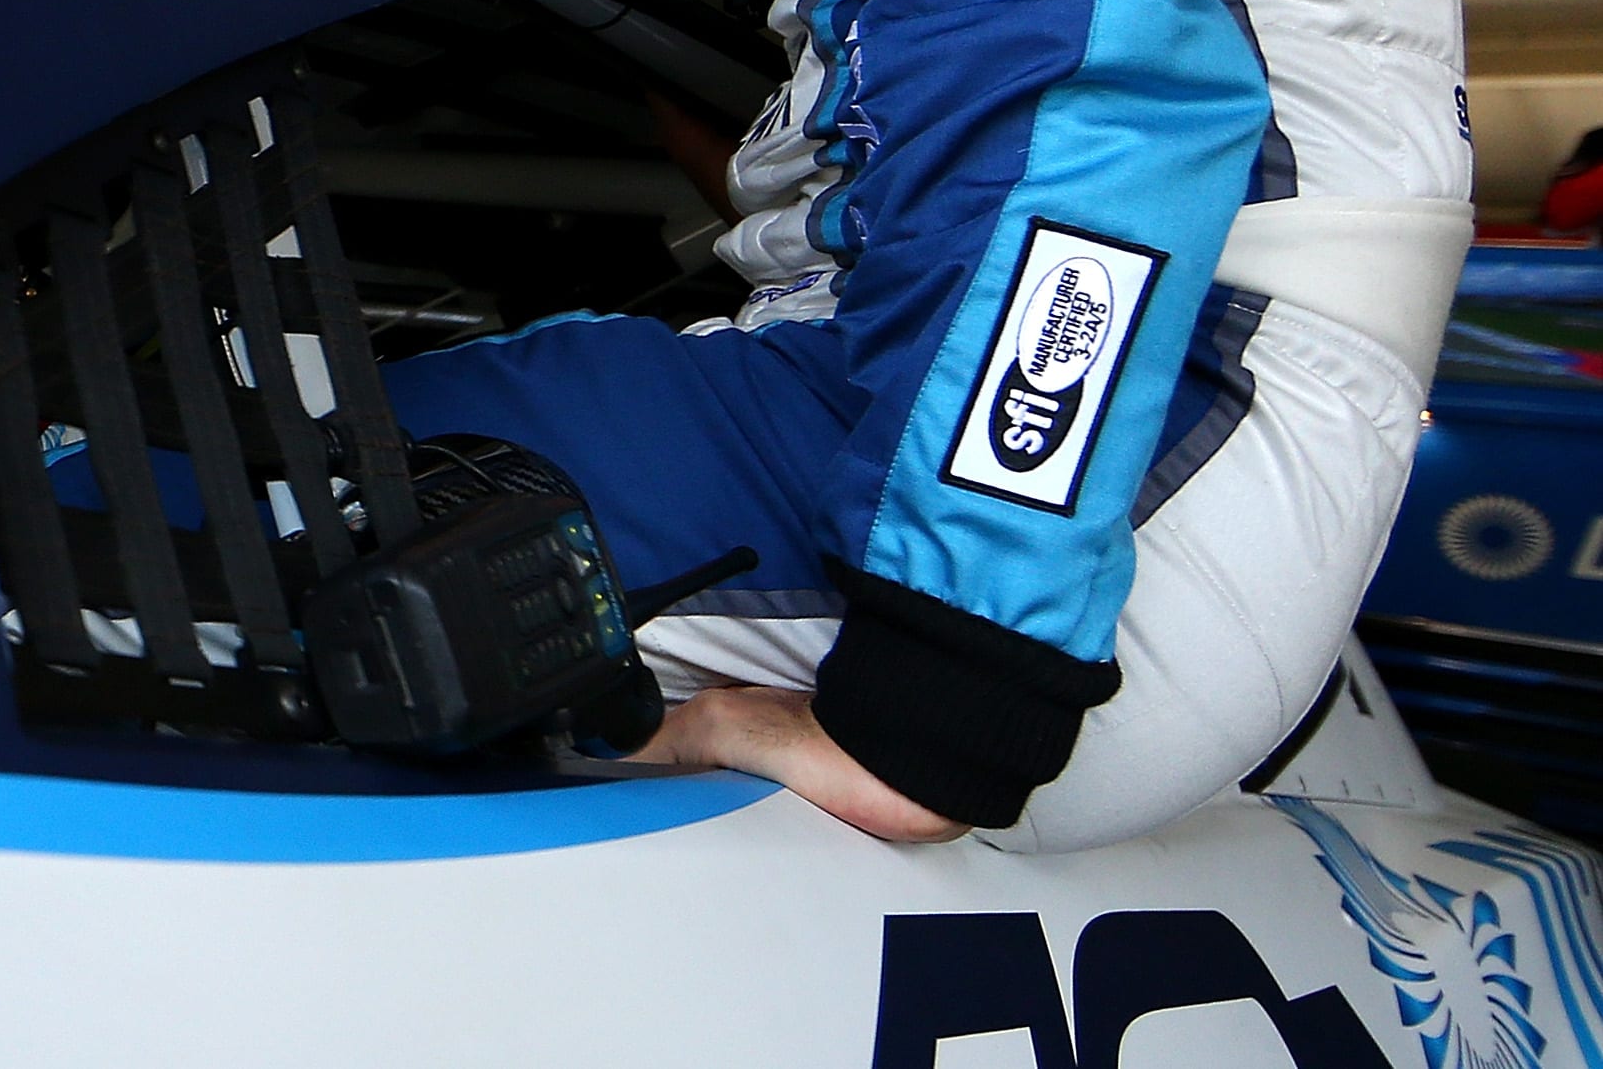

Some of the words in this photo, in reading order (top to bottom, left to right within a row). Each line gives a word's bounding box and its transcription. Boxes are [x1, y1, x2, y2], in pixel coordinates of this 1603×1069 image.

[1028, 267, 1080, 377] MANUFACTURER
[1053, 291, 1091, 364] CERTIFIED
[1073, 302, 1108, 361] 3-2A/5
